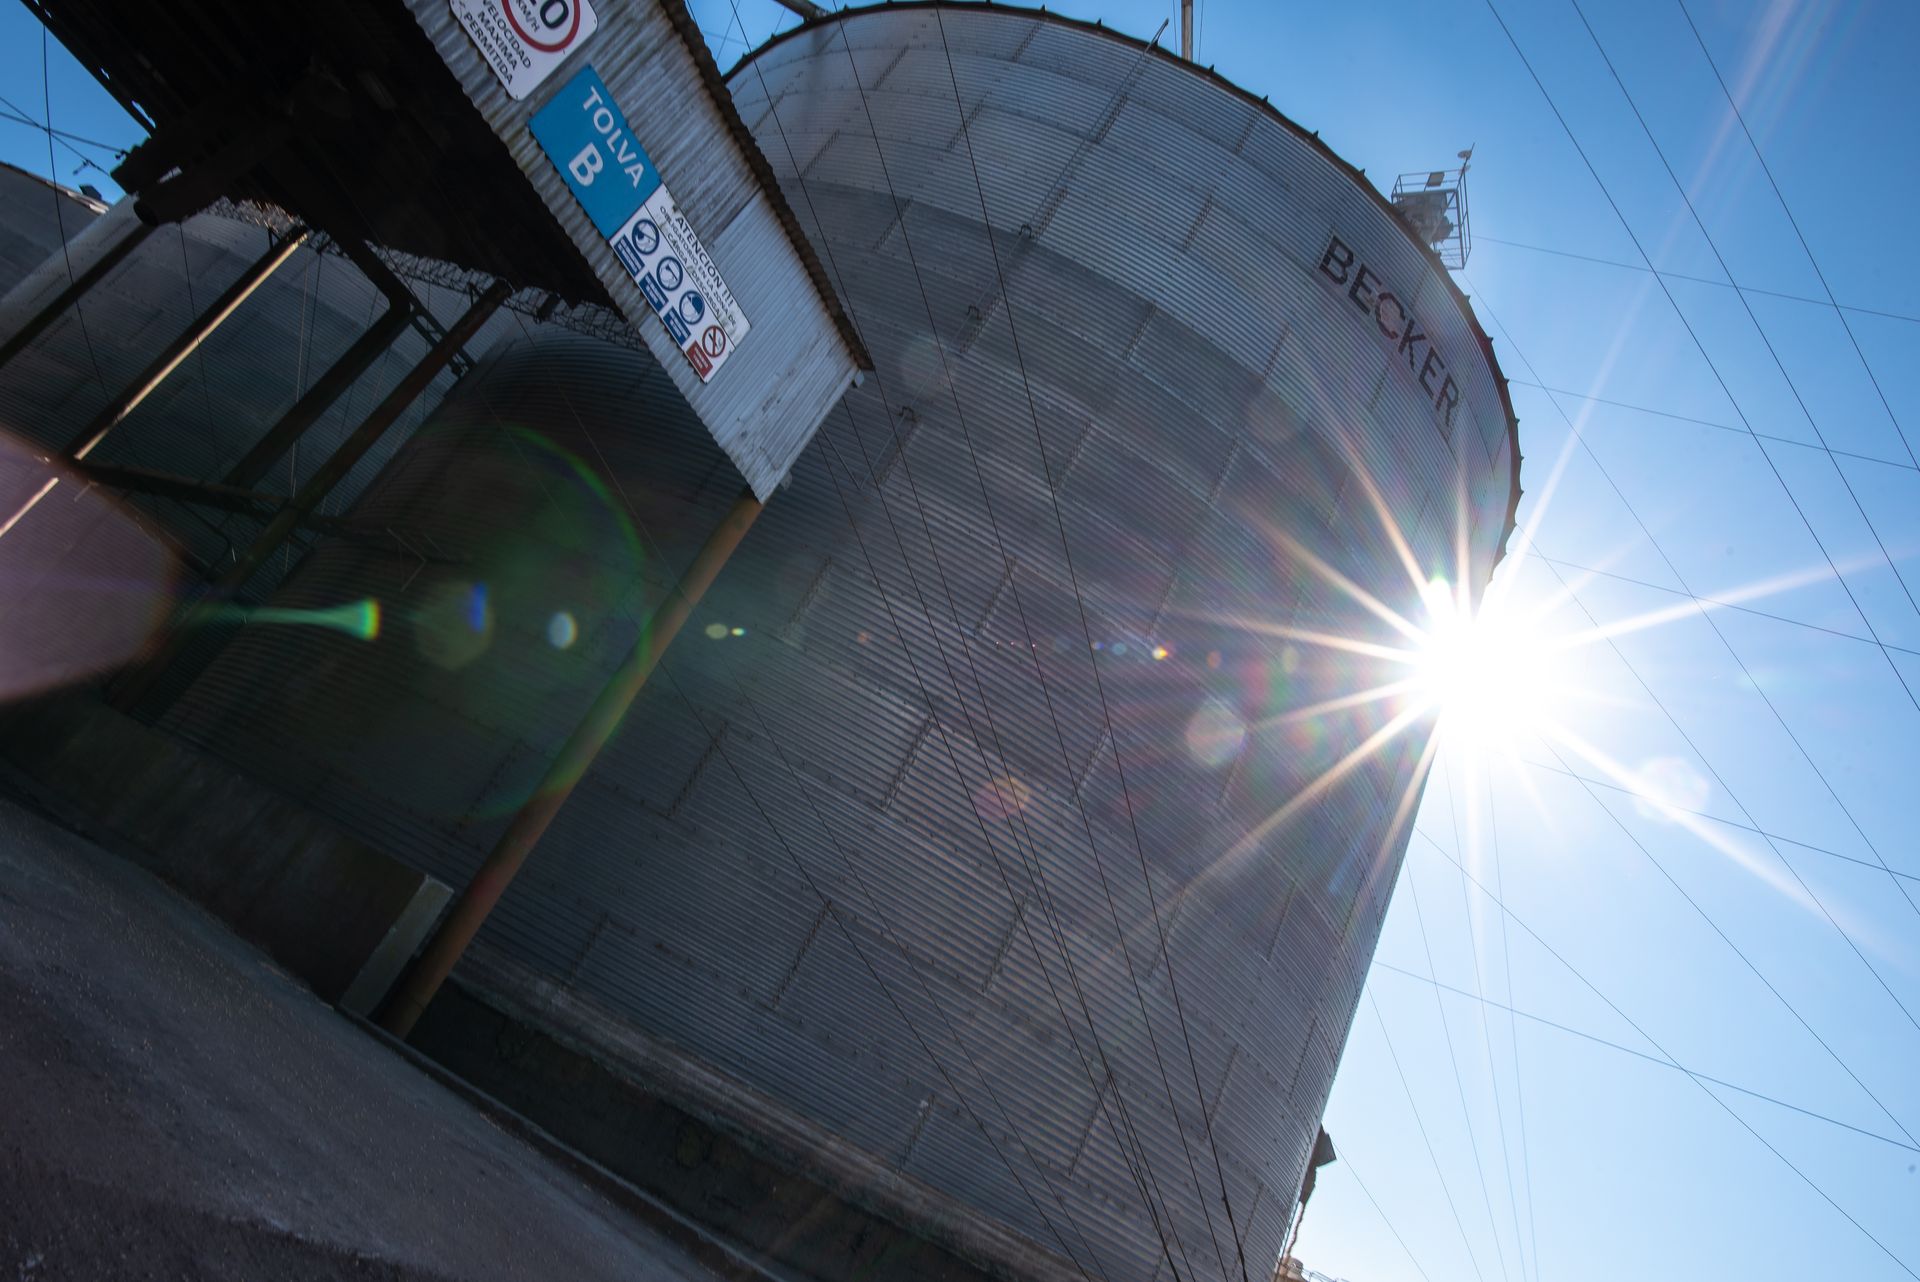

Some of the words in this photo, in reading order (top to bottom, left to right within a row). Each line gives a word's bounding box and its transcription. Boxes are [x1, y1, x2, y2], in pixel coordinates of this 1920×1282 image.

[464, 12, 512, 85] PERMITIDA
[477, 11, 517, 70] MAXIMA
[483, 0, 531, 68] VELOCIDAD
[530, 0, 569, 29] 0
[568, 143, 604, 187] B
[581, 86, 645, 190] TOLVA
[660, 206, 699, 265] OBLIGATORIO
[698, 266, 707, 279] EN
[707, 279, 714, 291] LA
[713, 291, 729, 315] ZONA
[728, 314, 737, 326] DE
[667, 233, 688, 265] CARGA
[1318, 235, 1459, 427] BECKER
